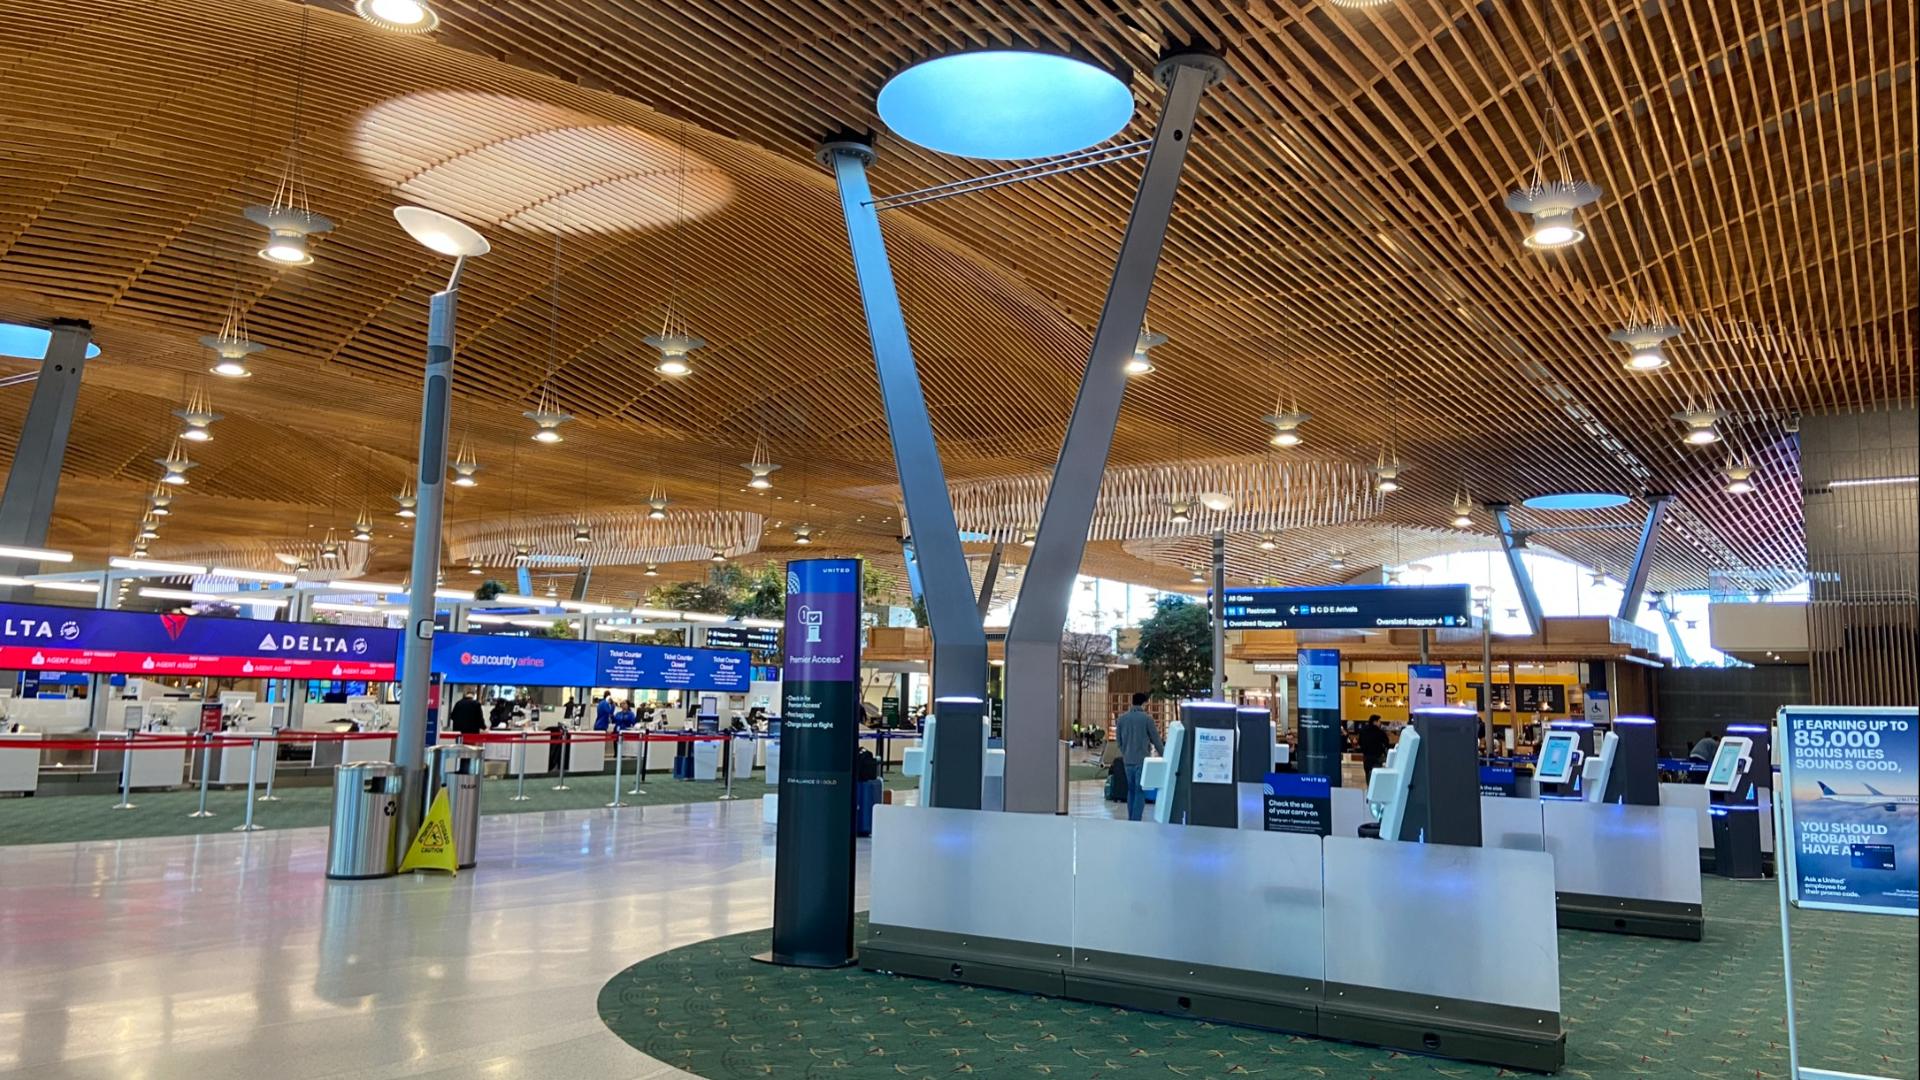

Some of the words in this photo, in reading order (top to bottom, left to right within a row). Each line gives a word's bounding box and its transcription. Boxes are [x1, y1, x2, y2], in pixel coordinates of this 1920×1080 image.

[1257, 620, 1282, 628] Baggage
[1408, 618, 1436, 626] Baggage
[282, 635, 348, 653] DELTA
[46, 656, 68, 665] AGENT
[69, 657, 92, 666] ASSIST
[518, 657, 545, 667] airlines
[789, 655, 811, 664] Premier
[1793, 720, 1804, 729] IF
[1806, 720, 1867, 731] EARNING
[1869, 720, 1888, 731] UP
[1890, 720, 1908, 731] TO
[1794, 731, 1880, 749] 85,000
[1795, 748, 1844, 758] BONUS
[1846, 748, 1884, 759] MILES
[1796, 759, 1853, 770] SOUNDS
[1856, 760, 1902, 773] GOOD,
[1268, 799, 1289, 807] Check
[1291, 810, 1318, 818] carry-on
[1801, 822, 1829, 832] YOU
[1831, 823, 1888, 835] SHOULD
[1802, 832, 1870, 844] PROBABLY
[1802, 844, 1839, 856] HAVE
[1841, 845, 1851, 856] A
